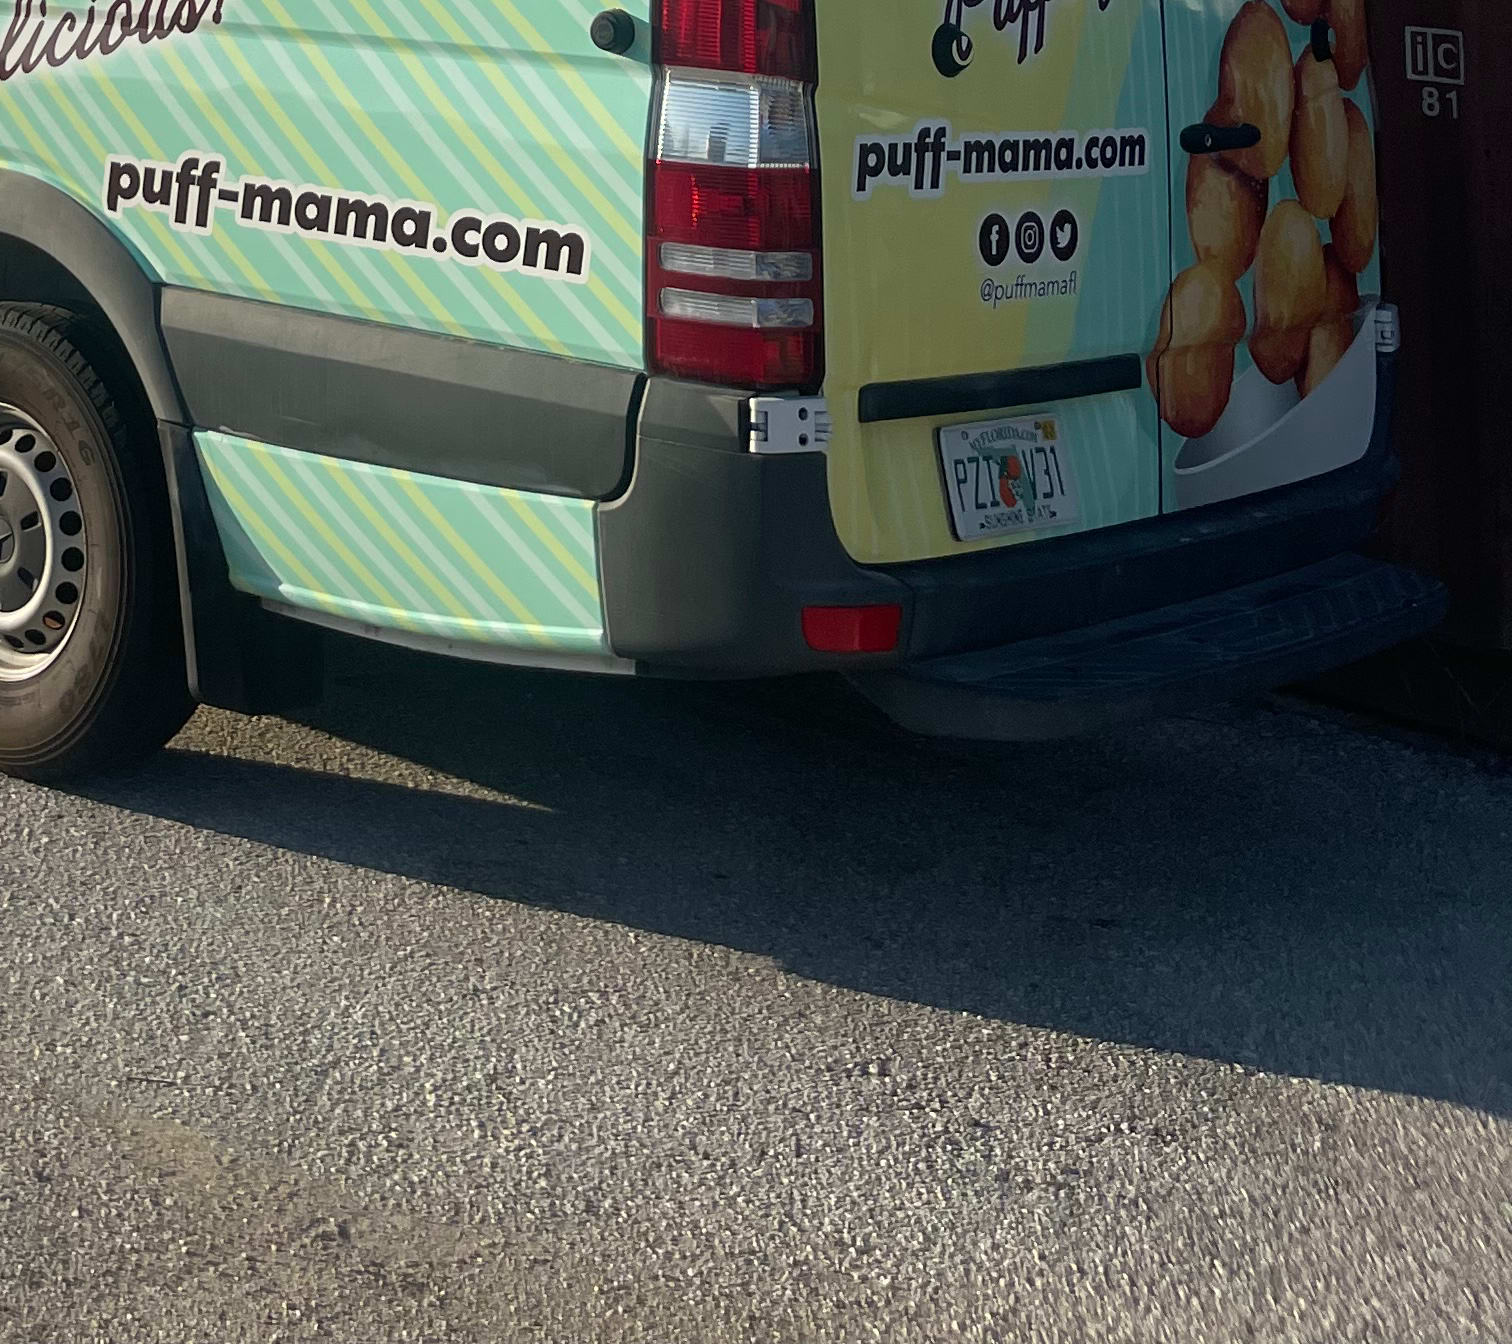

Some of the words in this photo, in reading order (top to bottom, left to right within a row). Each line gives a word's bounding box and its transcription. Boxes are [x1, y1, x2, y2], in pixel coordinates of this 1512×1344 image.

[1421, 86, 1458, 120] 81
[856, 126, 1146, 192] puff-mama.com
[106, 156, 586, 277] puff-mama.com
[980, 270, 1078, 310] @puffmamafl
